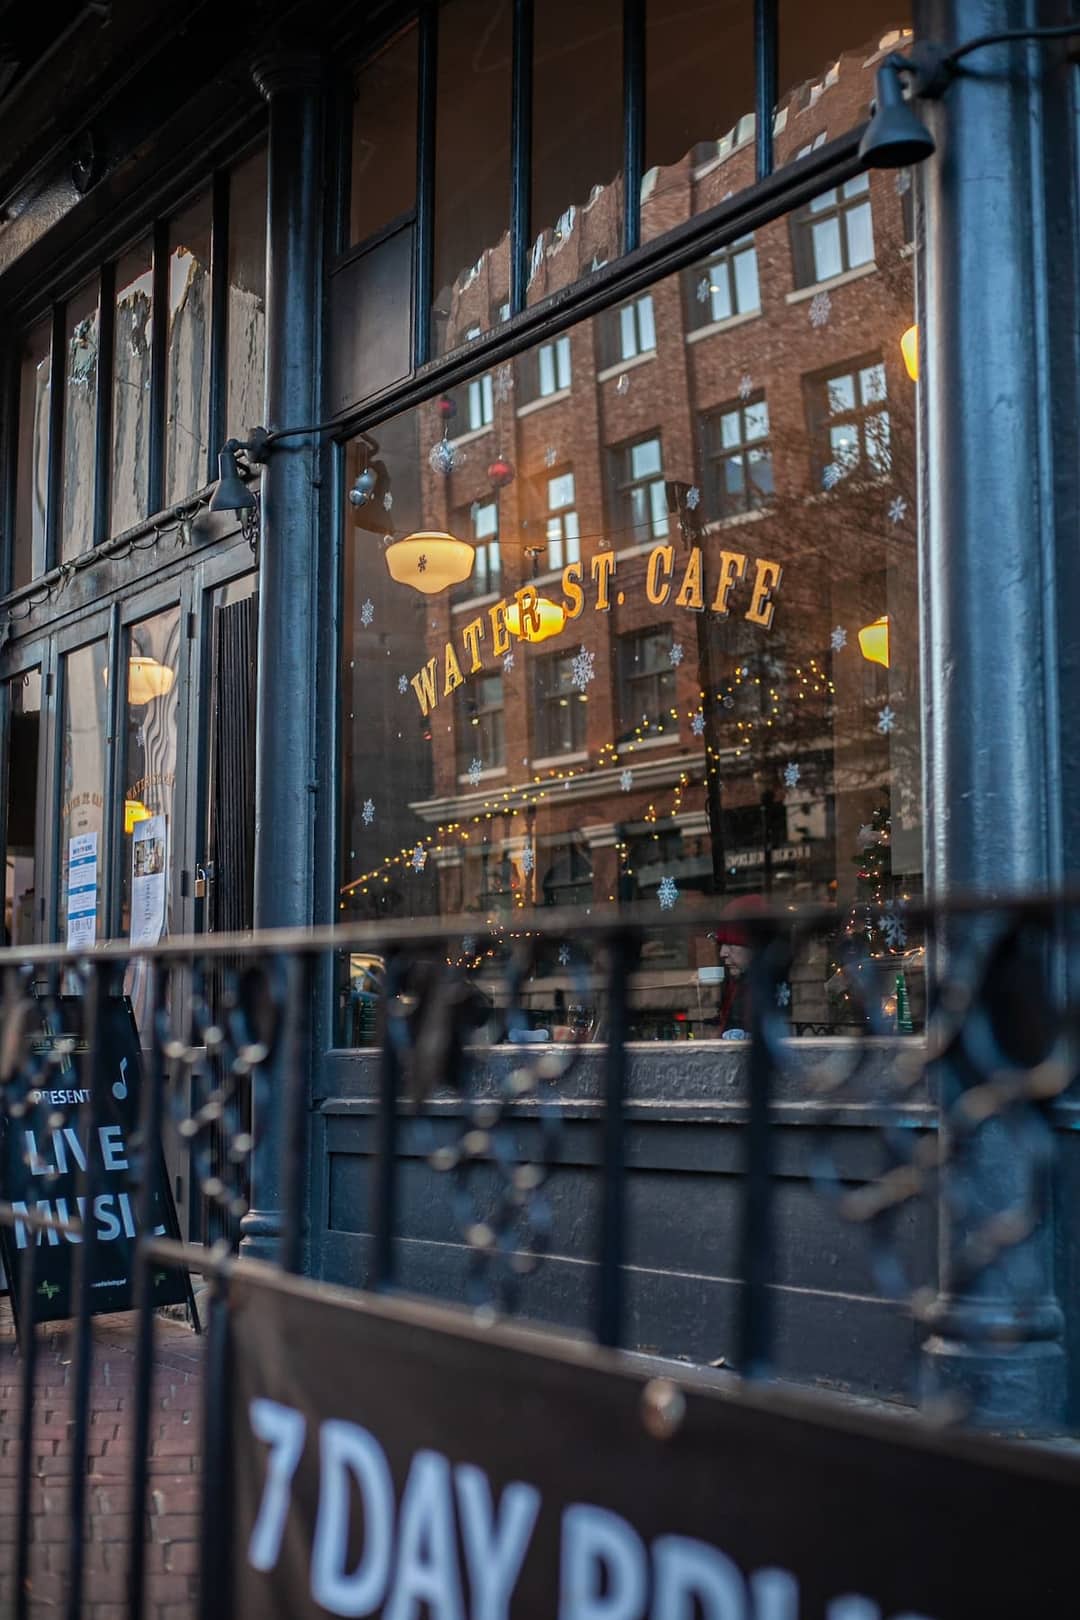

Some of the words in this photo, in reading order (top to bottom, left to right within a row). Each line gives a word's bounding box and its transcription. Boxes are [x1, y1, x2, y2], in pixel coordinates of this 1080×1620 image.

[411, 585, 541, 717] WATER
[561, 551, 626, 619] ST.
[646, 545, 783, 631] CAFE
[11, 1192, 167, 1249] MUSI
[248, 1397, 306, 1573] 7
[310, 1418, 542, 1620] DAY
